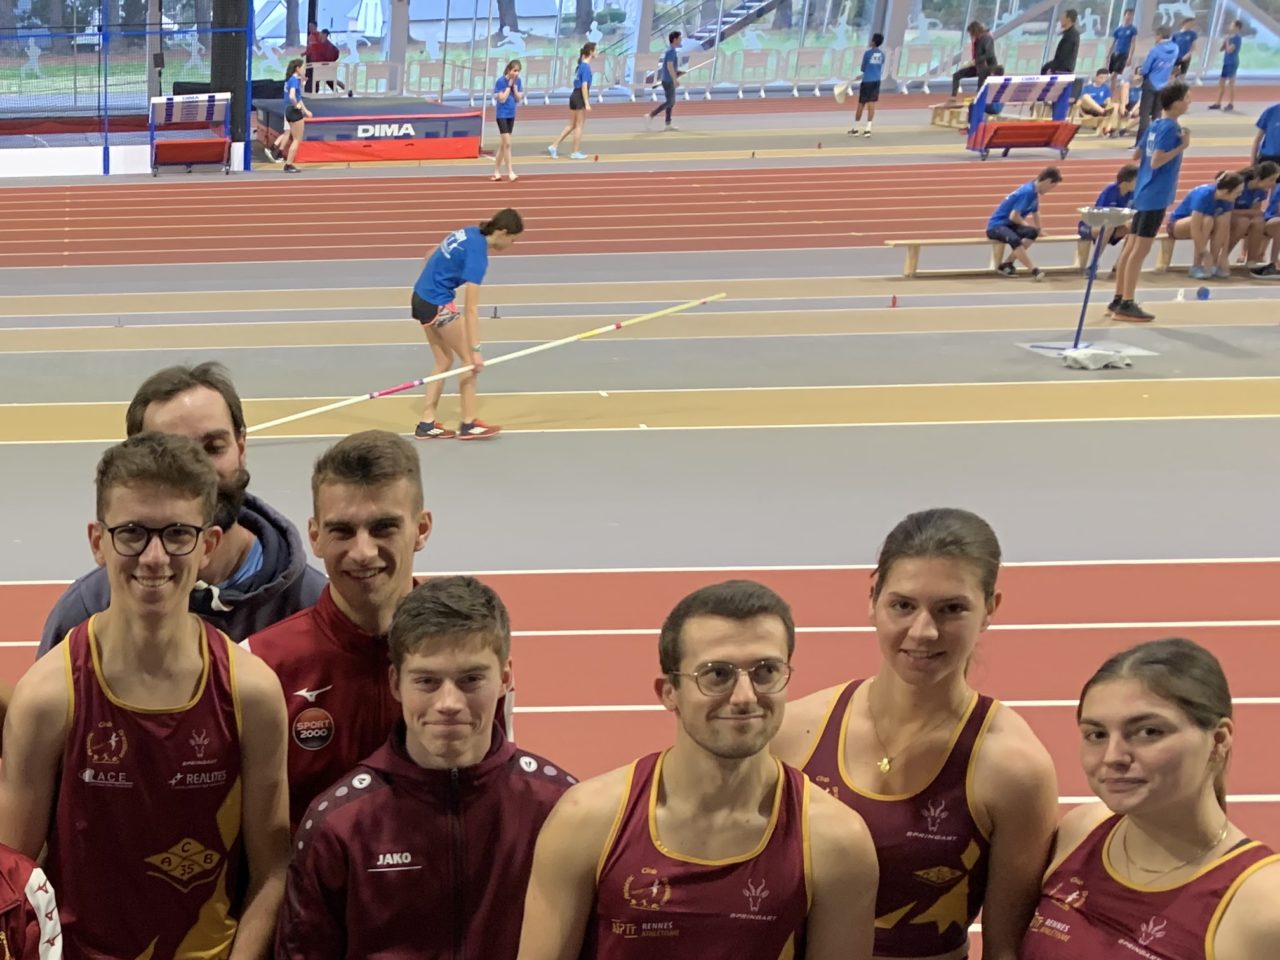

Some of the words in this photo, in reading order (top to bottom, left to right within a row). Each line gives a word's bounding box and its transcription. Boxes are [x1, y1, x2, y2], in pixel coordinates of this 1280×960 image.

[357, 123, 416, 138] DIMA
[296, 719, 330, 730] SPORT
[300, 728, 328, 738] 2000
[186, 770, 227, 785] REALITES
[376, 851, 412, 866] JAKO
